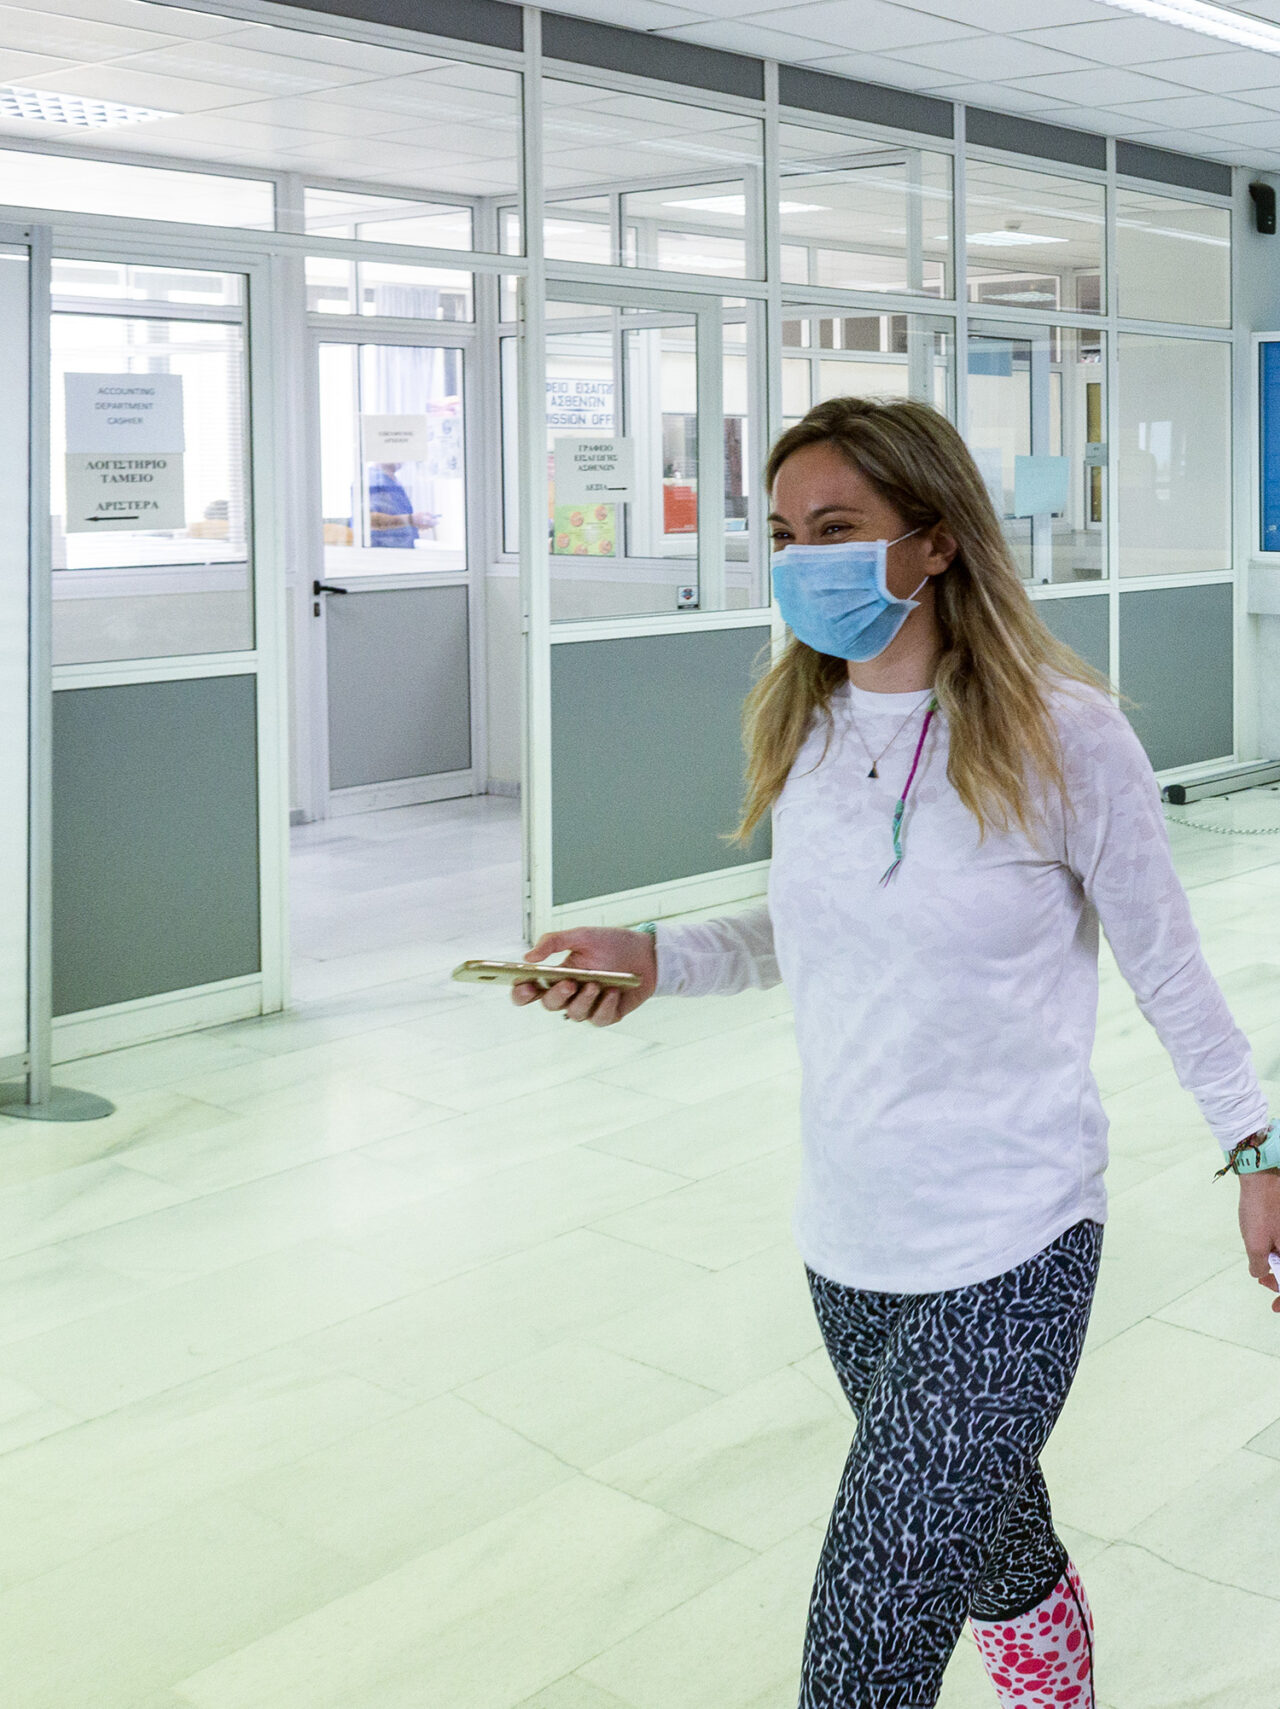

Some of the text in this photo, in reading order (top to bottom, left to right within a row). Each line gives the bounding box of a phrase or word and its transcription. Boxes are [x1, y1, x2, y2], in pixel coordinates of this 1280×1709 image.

[551, 395, 606, 407] ΑΣΘΕΝΩΝ
[95, 402, 154, 410] DEPARTMENT
[107, 417, 143, 425] CASHIER
[86, 460, 167, 470] ΛΟΓΙΣΤΗΡΙΟ
[101, 474, 153, 483] ΤΑΜΕΙΟ
[96, 501, 159, 511] ΑΡΙΣΤΕΡΑ
